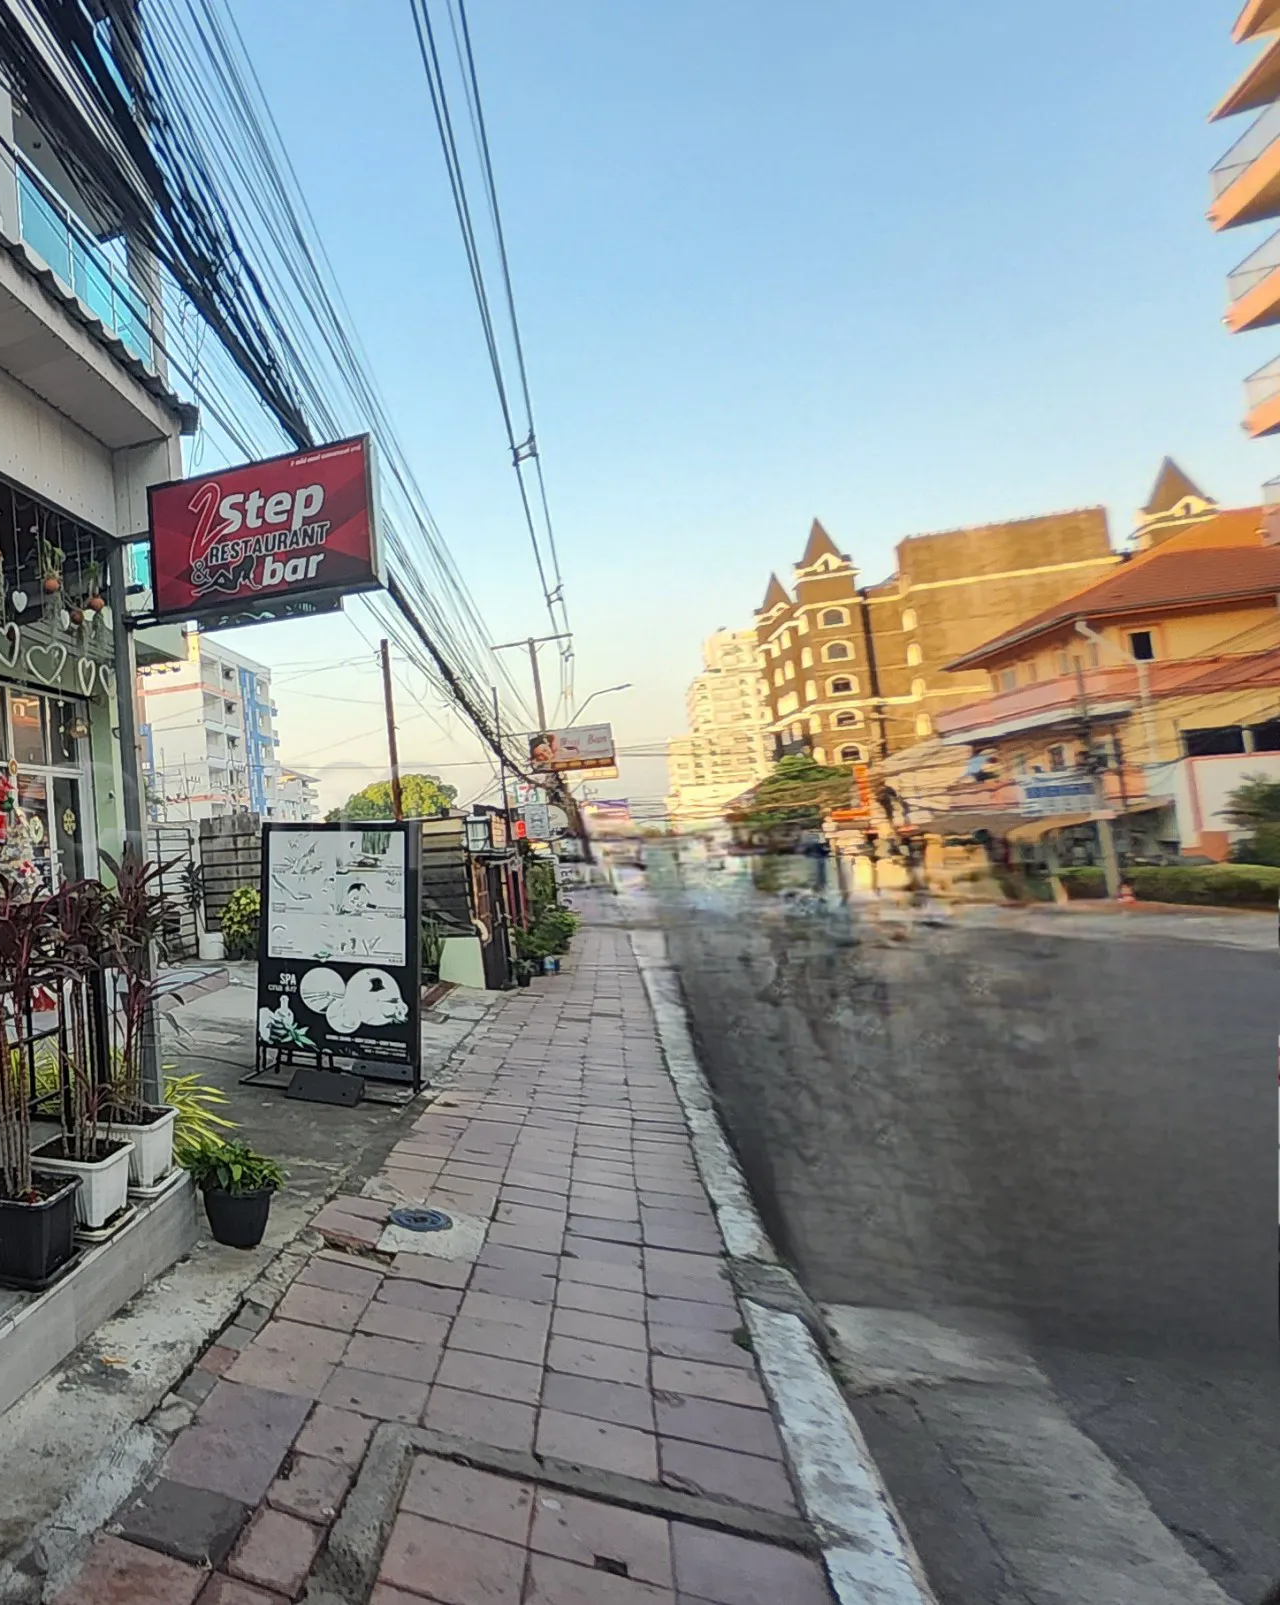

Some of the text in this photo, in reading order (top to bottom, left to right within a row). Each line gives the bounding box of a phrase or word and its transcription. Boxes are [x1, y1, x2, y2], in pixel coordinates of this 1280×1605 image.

[188, 482, 325, 565] 2 Step
[209, 521, 330, 567] RESTAURANT
[191, 553, 325, 587] & bar
[279, 972, 297, 986] SPA
